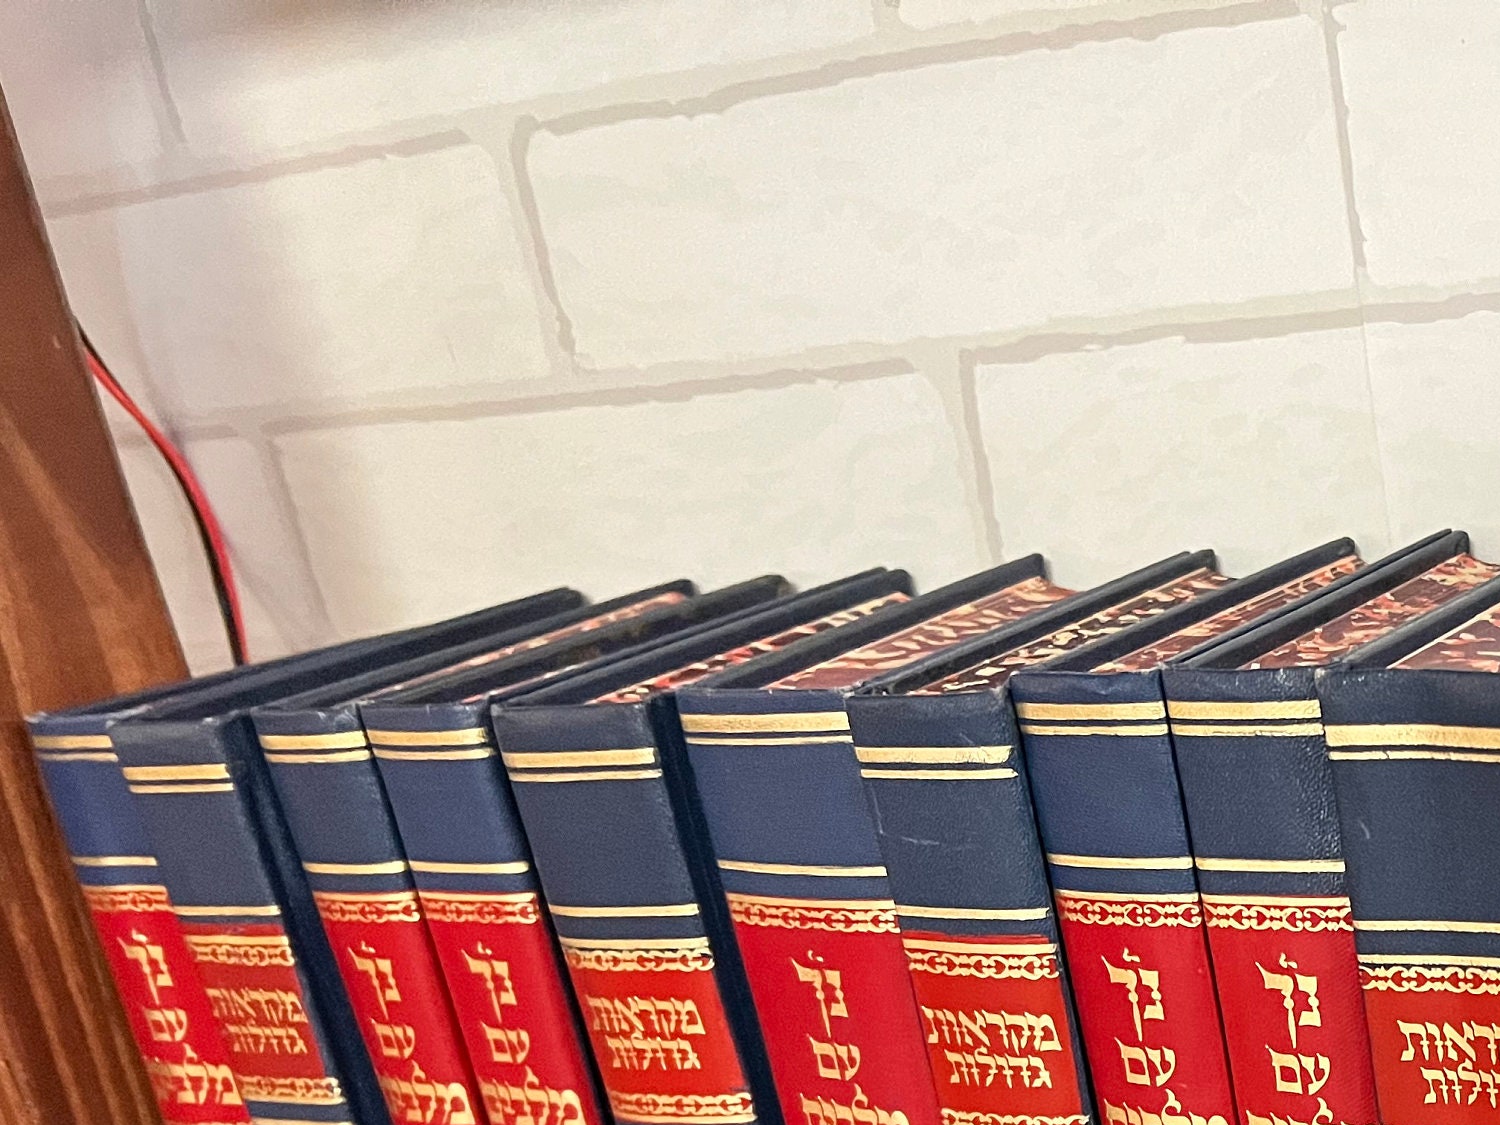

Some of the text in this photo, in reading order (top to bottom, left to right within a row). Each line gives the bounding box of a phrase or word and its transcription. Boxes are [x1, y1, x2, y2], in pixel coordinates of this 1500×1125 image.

[143, 1006, 188, 1042] עם
[204, 987, 309, 1026] מקראות
[585, 994, 706, 1039] מקראות
[224, 1018, 308, 1054] גדולות
[370, 1017, 416, 1058] עם
[481, 1020, 530, 1064] עם
[605, 1031, 701, 1071] גדולות
[920, 1004, 1062, 1055] מקראות
[806, 1033, 861, 1081] עם
[944, 1046, 1053, 1089] גדולות
[1114, 1036, 1176, 1087] עם
[1265, 1044, 1331, 1095] עם
